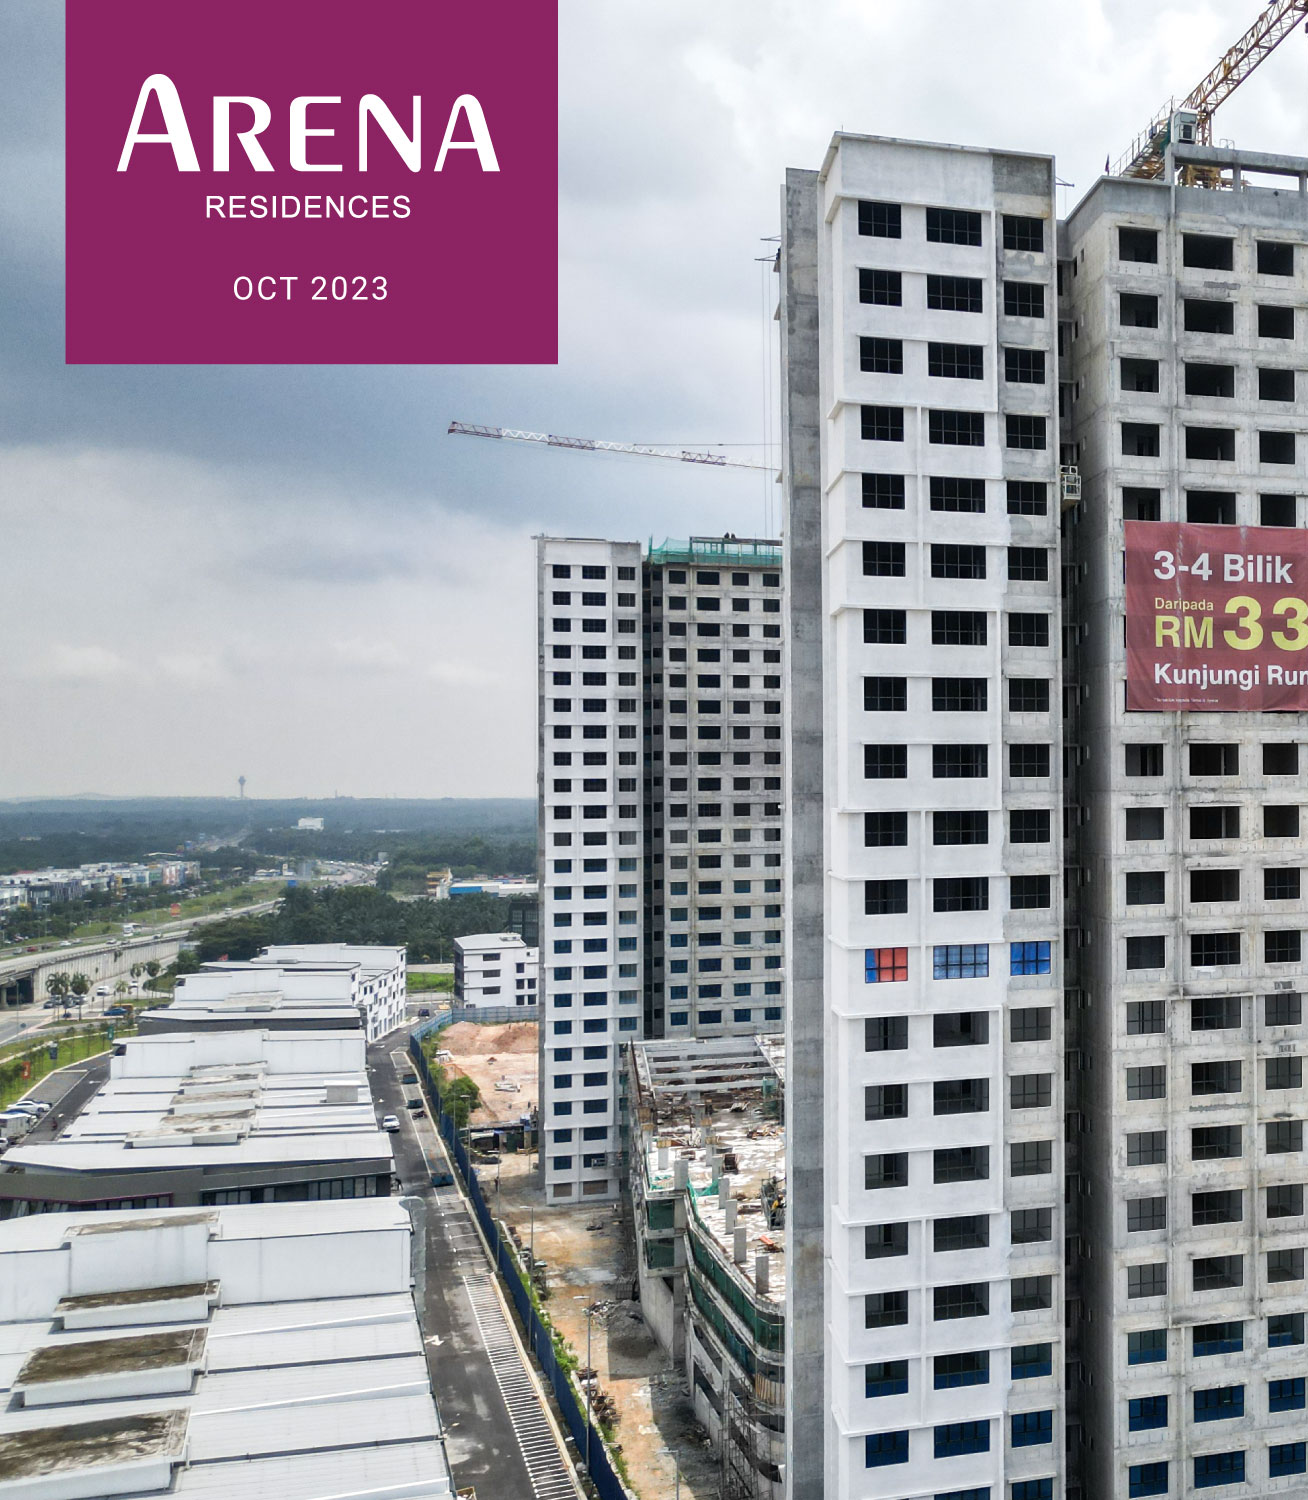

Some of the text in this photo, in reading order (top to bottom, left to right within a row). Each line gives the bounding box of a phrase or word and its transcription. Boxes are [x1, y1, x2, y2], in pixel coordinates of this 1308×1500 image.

[1153, 551, 1293, 584] 3-4 Bilik
[1154, 597, 1214, 612] Daripada
[1154, 615, 1214, 649] RM
[1154, 663, 1260, 691] Kunjungi
